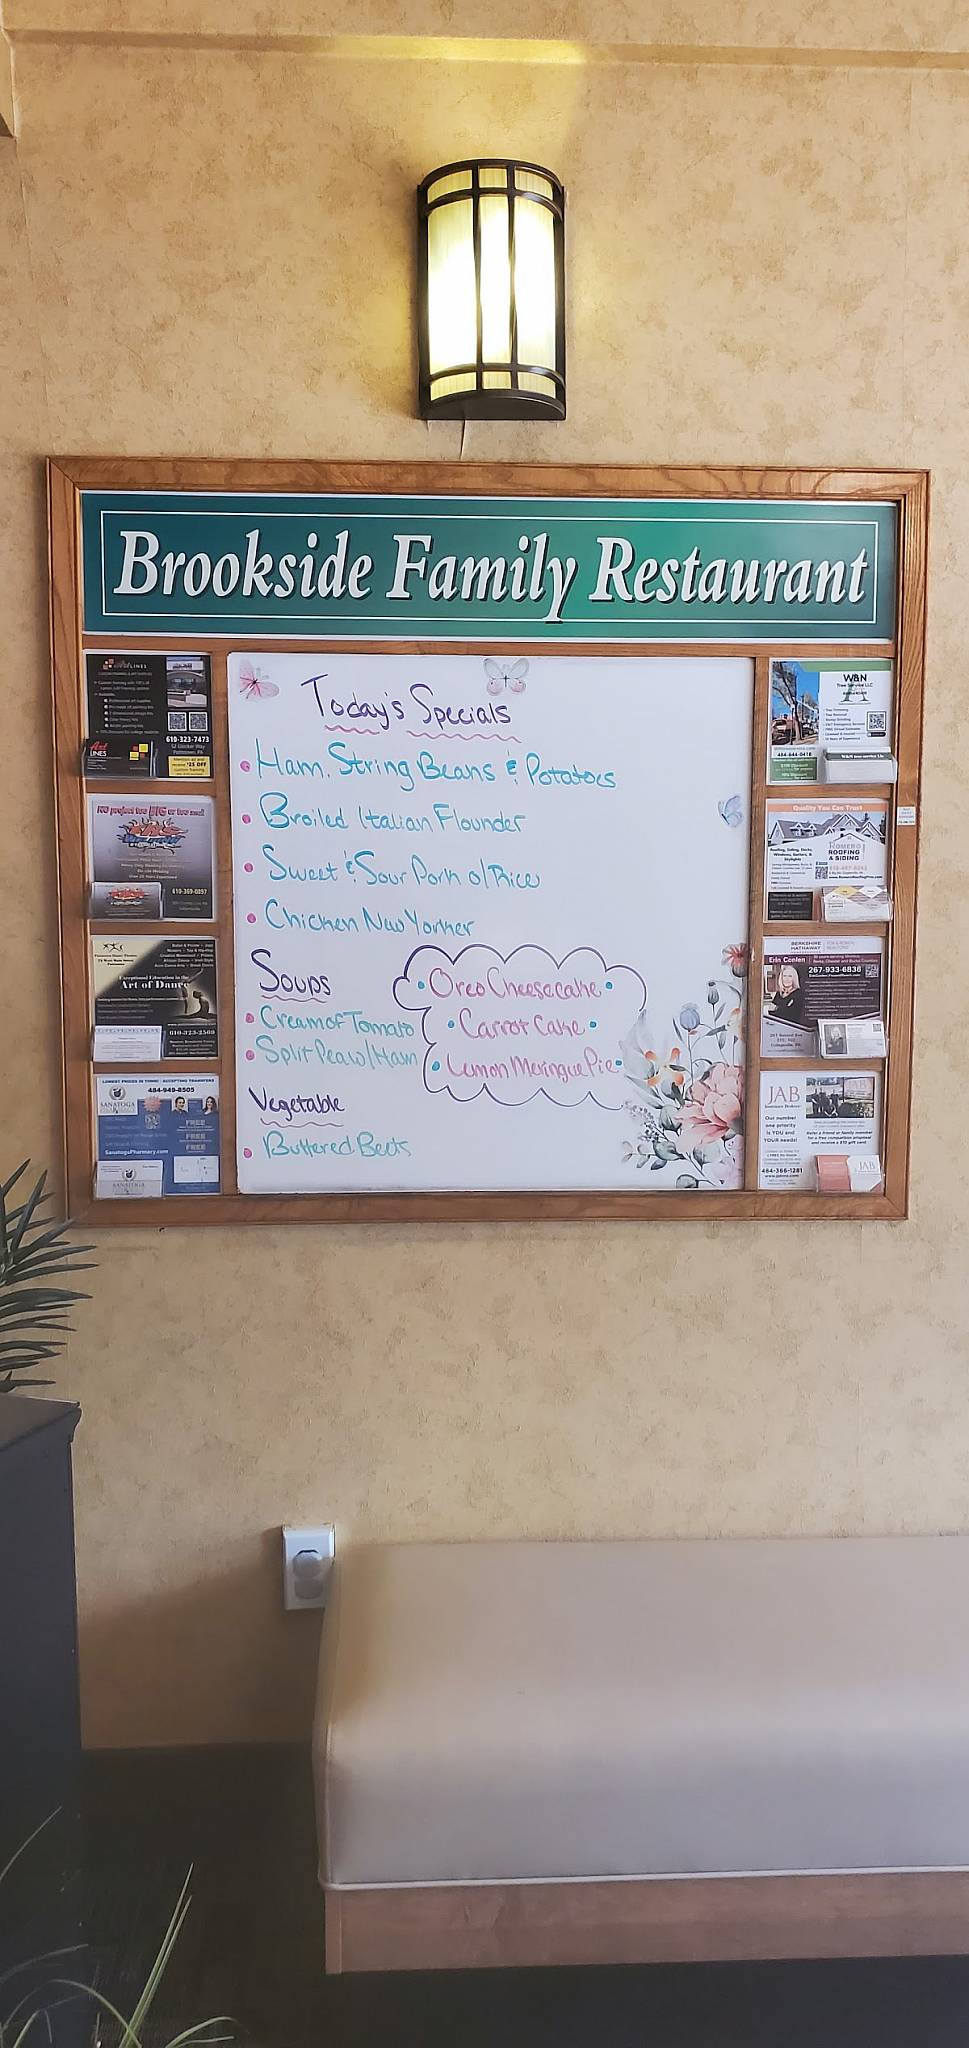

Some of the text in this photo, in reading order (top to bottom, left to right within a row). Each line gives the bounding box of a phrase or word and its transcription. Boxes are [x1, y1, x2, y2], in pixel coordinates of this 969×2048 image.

[113, 529, 870, 624] Brookside Family Restaurant
[843, 674, 867, 682] W&N
[409, 683, 512, 729] Specials
[328, 742, 415, 792] String
[416, 751, 496, 782] Beans
[260, 791, 526, 833] Broiled Italian Flounder
[262, 844, 338, 881] Sweet
[354, 850, 407, 886] Sour
[264, 898, 475, 937] Chicken New Yorker
[121, 981, 138, 989] Art
[251, 948, 331, 996] Soups
[429, 966, 602, 1000] Oreo Cheesecake
[260, 1005, 324, 1030] Cream
[343, 1010, 415, 1038] Tomato
[459, 1007, 585, 1039] Carrot Cake
[255, 1035, 314, 1066] Split
[447, 1046, 619, 1084] Lemon Meringue Pie
[248, 1086, 345, 1121] Vegetable
[768, 1086, 800, 1104] JAB
[262, 1130, 412, 1159] Buttered Beets
